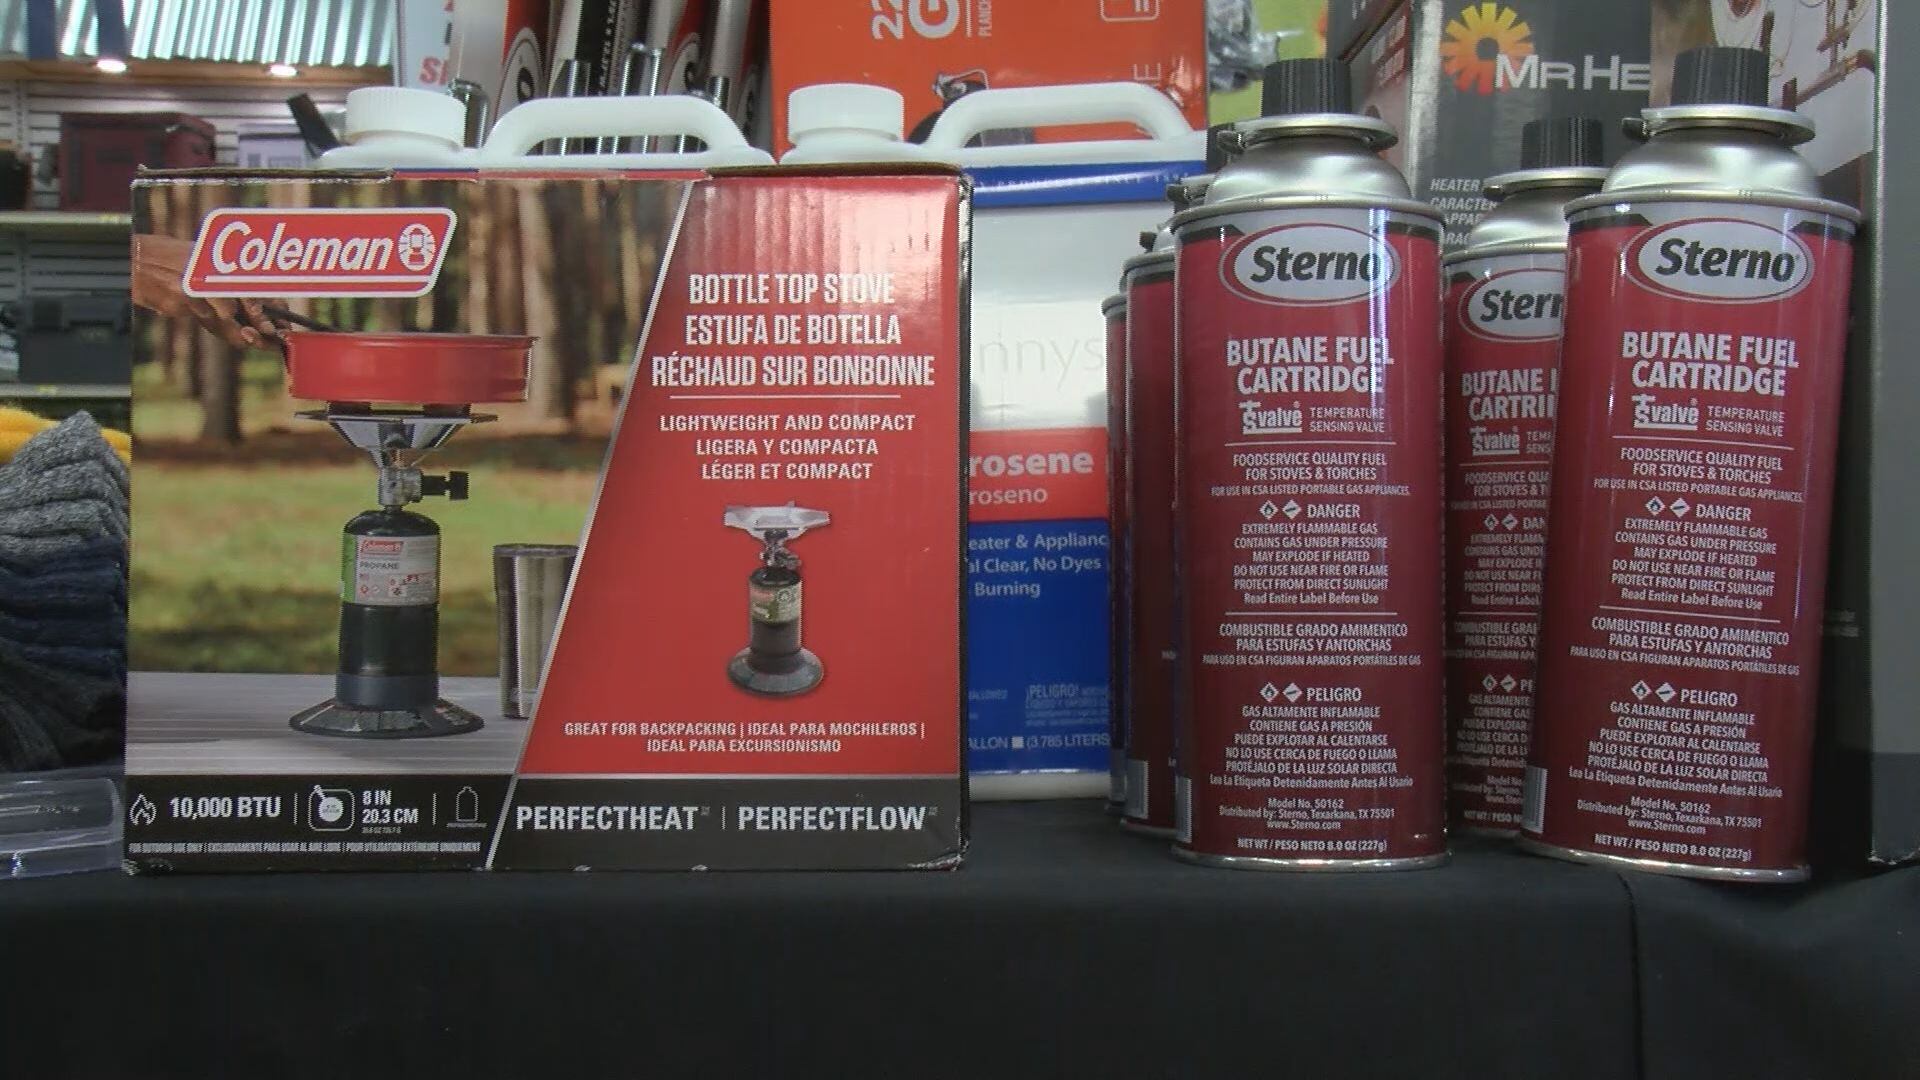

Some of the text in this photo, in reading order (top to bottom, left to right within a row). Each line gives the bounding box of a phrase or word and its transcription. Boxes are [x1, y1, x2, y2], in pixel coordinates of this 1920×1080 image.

[1430, 178, 1481, 192] HEATER
[212, 221, 394, 274] Coleman
[1250, 245, 1382, 283] Sterno
[1655, 238, 1795, 282] Sterno
[689, 273, 896, 304] BOTTLE TOP STOVE
[686, 314, 902, 345] ESTUFA DE BOTELLA
[1227, 336, 1395, 366] BUTANE FUEL
[1622, 331, 1800, 368] BUTANE FUEL
[652, 350, 935, 387] RÉCHAUD SUR BONBONNE
[1631, 361, 1786, 396] CARTRIDGE
[1237, 365, 1384, 395] CARTRIDGE
[1461, 368, 1543, 396] BUTANE
[659, 414, 915, 432] LIGHTWEIGHT AND COMPACT
[1309, 406, 1385, 420] TEMPERATURE
[1707, 405, 1785, 423] TEMPERATURE
[1309, 420, 1385, 433] SENSING VALVE
[1705, 420, 1784, 437] SENSING VALVE
[696, 438, 879, 455] LIGERA Y COMPACTA
[701, 459, 873, 480] LÉGER ET COMPACT
[1233, 451, 1387, 467] FOODSERVICE QUALITY FUEL
[1621, 447, 1783, 471] FOODSERVICE QUALITY FUEL
[1245, 467, 1377, 481] FOR STOVES & TORCHES
[1633, 463, 1771, 484] FOR STOVES & TORCHES
[1306, 503, 1361, 518] DANGER
[1696, 504, 1751, 520] DANGER
[1625, 518, 1768, 539] EXTREMELY FLAMMABLE GAS
[1615, 531, 1776, 554] CONTAINS GAS UNDER PRESSURE
[984, 557, 1029, 573] Clear,
[1033, 557, 1057, 571] No
[1061, 556, 1102, 573] Dyes
[1634, 547, 1757, 567] MAY EXPLODE IF HEATED
[1613, 559, 1775, 583] DO NOT USE NEAR FIRE OR FLAME
[974, 581, 1041, 598] Burning
[1611, 573, 1774, 596] PROTECT FROM DIRECT SUNLIGHT
[1621, 588, 1763, 610] Read Entire Label Before Use
[1219, 623, 1294, 637] COMBUSTIBLE
[1296, 623, 1338, 637] GRADO
[1591, 616, 1671, 635] COMBUSTIBLE
[1674, 623, 1719, 639] GRADO
[1236, 638, 1392, 652] PARA ESTUFAS Y ANTORCHAS
[1609, 633, 1772, 659] PARA ESTUFAS Y ANTORCHAS
[1306, 687, 1362, 702] PELIGRO
[1680, 689, 1738, 707] PELIGRO
[1610, 701, 1755, 725] GAS ALTAMENTE INFLAMABLE
[564, 722, 736, 737] GREAT FOR BACKPACKING
[747, 723, 918, 737] IDEAL PARA MOCHILEROS
[647, 739, 842, 753] IDEAL PARA EXCURSIONISMO
[362, 790, 392, 805] 8 IN
[1631, 796, 1661, 809] Model
[1681, 802, 1711, 815] 50162
[170, 797, 281, 820] 10,000 BTU
[362, 808, 419, 824] 20.3 CM
[516, 806, 699, 830] PERFECTHEAT
[738, 806, 927, 832] PERFECTFLOW
